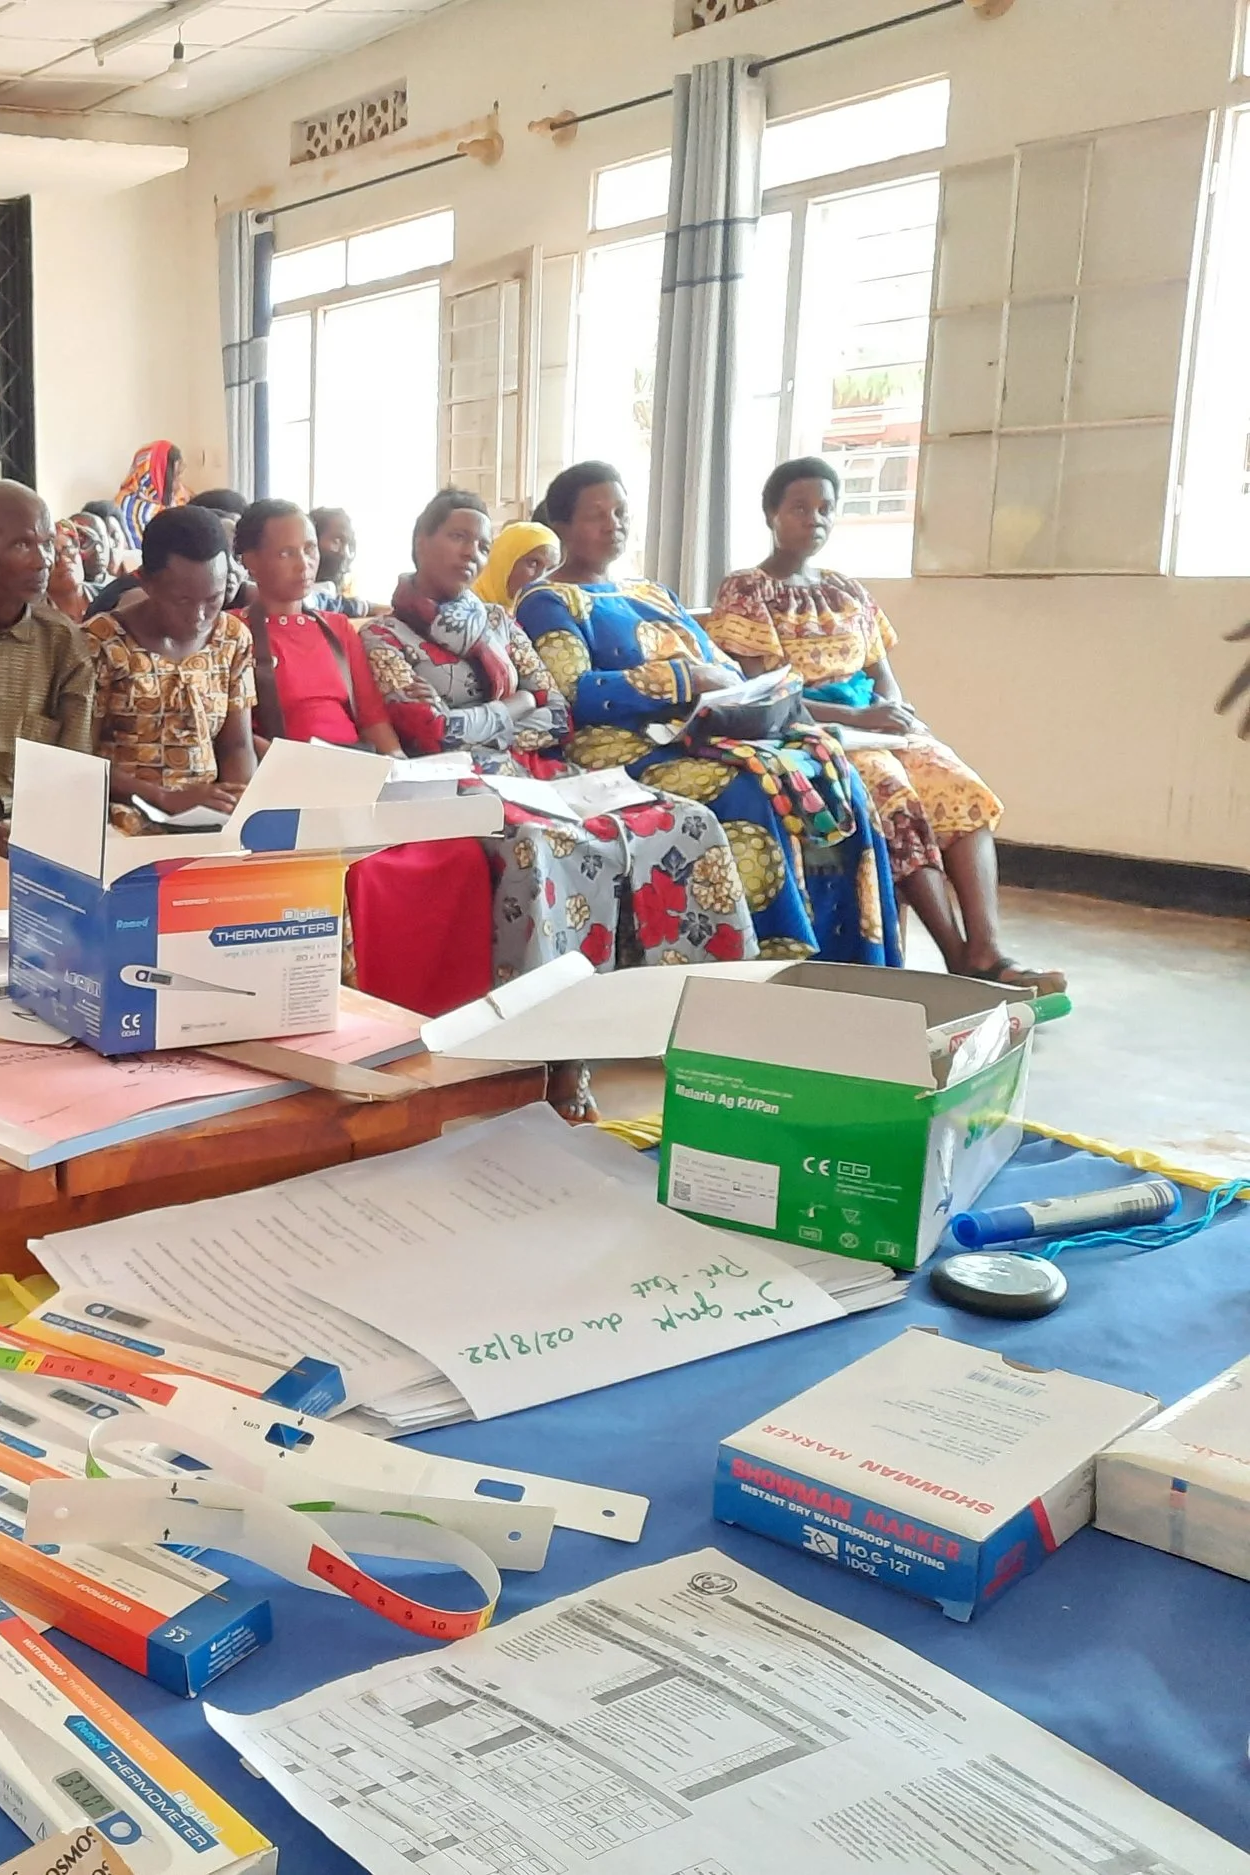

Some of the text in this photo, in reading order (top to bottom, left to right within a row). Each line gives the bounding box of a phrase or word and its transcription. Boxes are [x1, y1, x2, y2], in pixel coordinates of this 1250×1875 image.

[116, 916, 148, 930] Romed
[282, 908, 330, 922] Digital
[216, 922, 334, 941] THERMOMETERS
[121, 1014, 141, 1029] CE
[675, 1084, 779, 1114] Malaria Ag P.f/Pan
[803, 1157, 831, 1176] CE
[629, 1272, 679, 1302] test
[583, 1313, 623, 1332] du
[243, 1419, 260, 1430] cm
[760, 1424, 995, 1516] SHOWMAN MARKER
[730, 1457, 961, 1562] SHOWMAN MARKER
[739, 1482, 945, 1570] INSTANT DRY WATERPROOF WRITING
[77, 1581, 134, 1613] WATERPROOF
[352, 1580, 360, 1590] 7
[377, 1595, 385, 1607] 8
[404, 1610, 413, 1621] 9
[430, 1620, 447, 1631] 10
[164, 1628, 186, 1644] CE
[23, 1638, 66, 1678] WATERPROOF
[73, 1720, 207, 1849] Romed THERMOMETER
[172, 1790, 219, 1836] Digital
